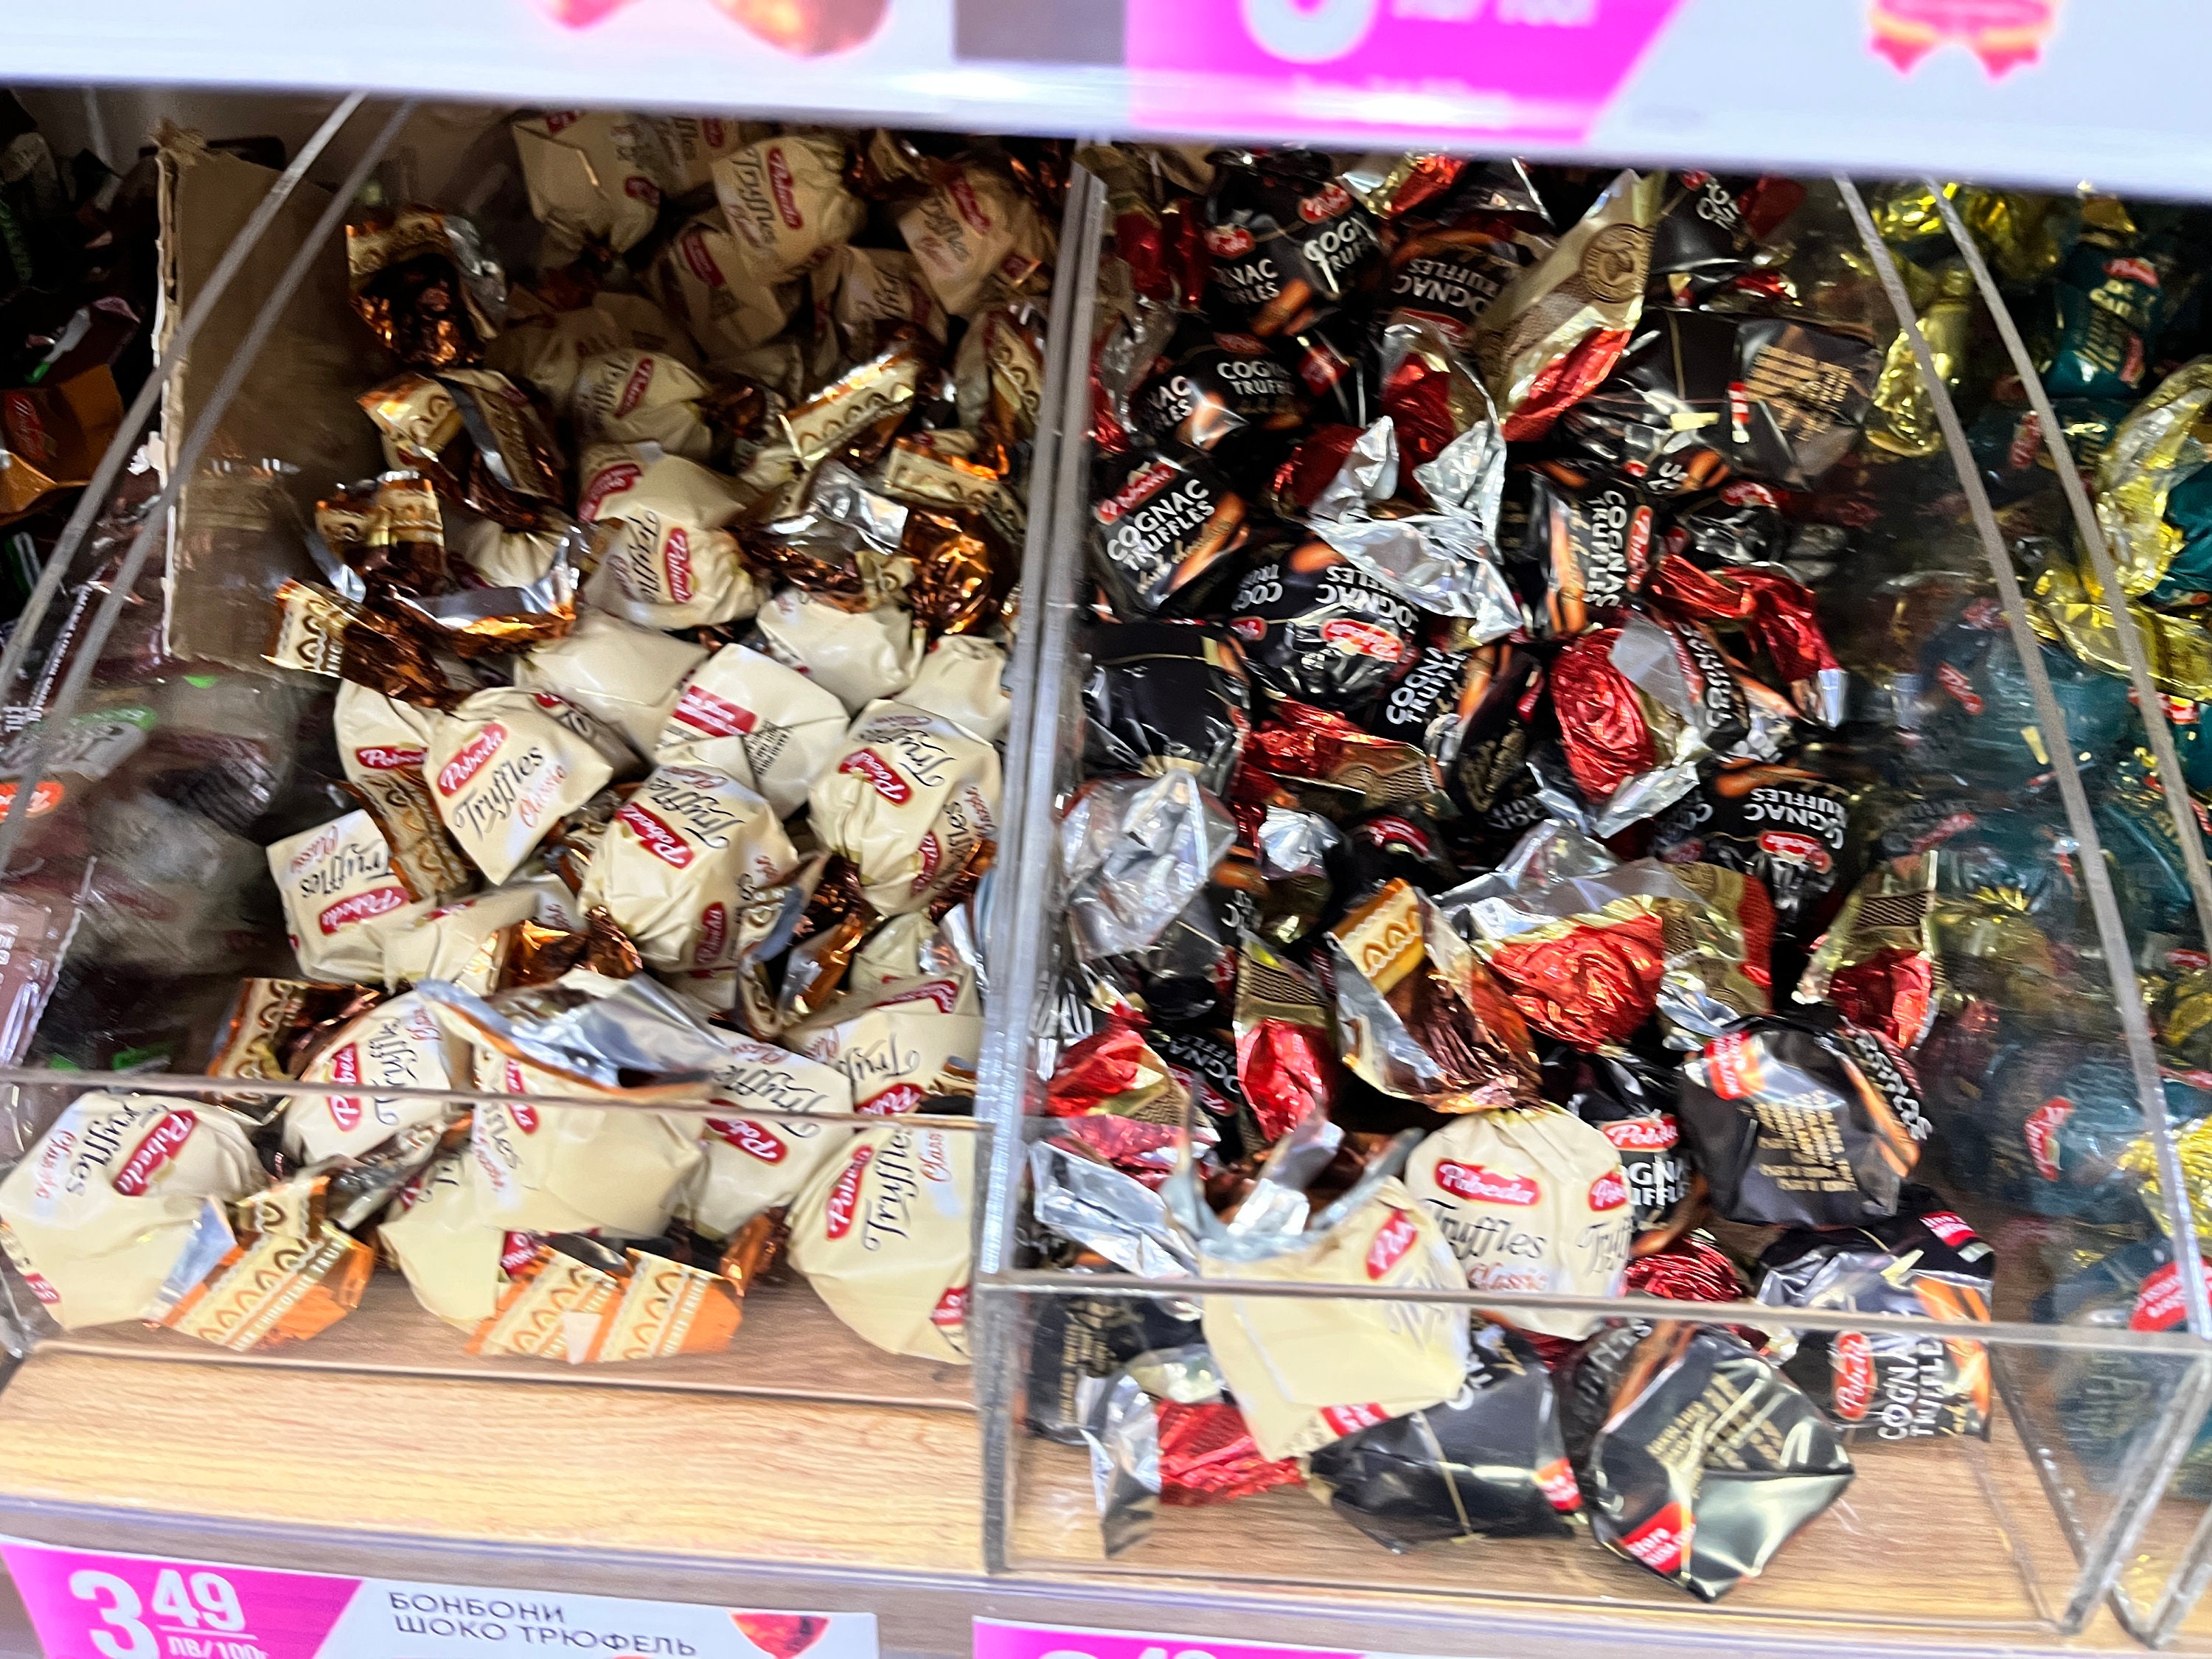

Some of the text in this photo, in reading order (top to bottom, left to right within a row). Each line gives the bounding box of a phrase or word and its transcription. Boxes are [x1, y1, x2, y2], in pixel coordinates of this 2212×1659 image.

[1391, 274, 1493, 317] OGNAC
[1107, 479, 1209, 560] COGNAC
[453, 745, 545, 841] Truffles
[714, 1065, 829, 1138] Truffle
[1439, 1164, 1535, 1205] Pobeda
[1877, 1346, 1919, 1441] COGNA
[69, 1569, 161, 1659] 3
[151, 1568, 246, 1633] 49
[387, 1590, 566, 1624] БОНБОНИ
[393, 1614, 698, 1657] ШОКО ТРЮФЕЛЬ
